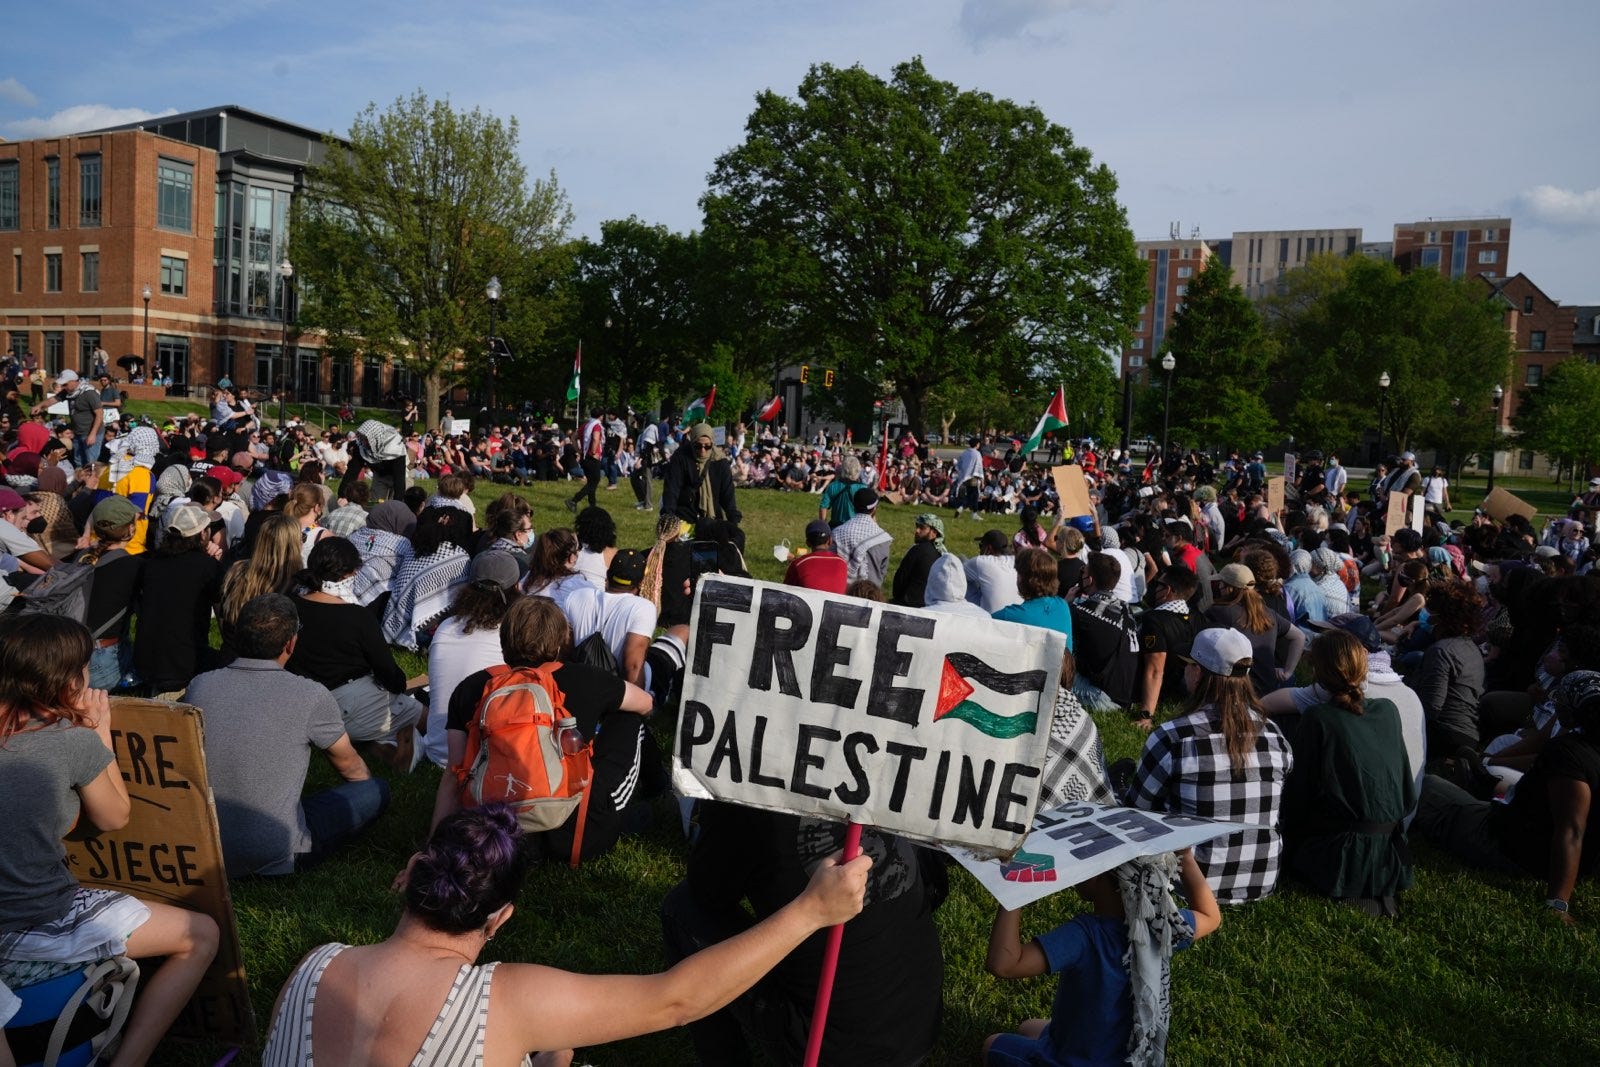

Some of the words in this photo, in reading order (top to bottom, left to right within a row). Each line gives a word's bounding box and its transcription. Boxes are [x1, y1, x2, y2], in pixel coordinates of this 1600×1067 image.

[692, 579, 937, 729] FREE
[678, 700, 1041, 835] PALESTINE
[84, 836, 205, 888] SIEGE
